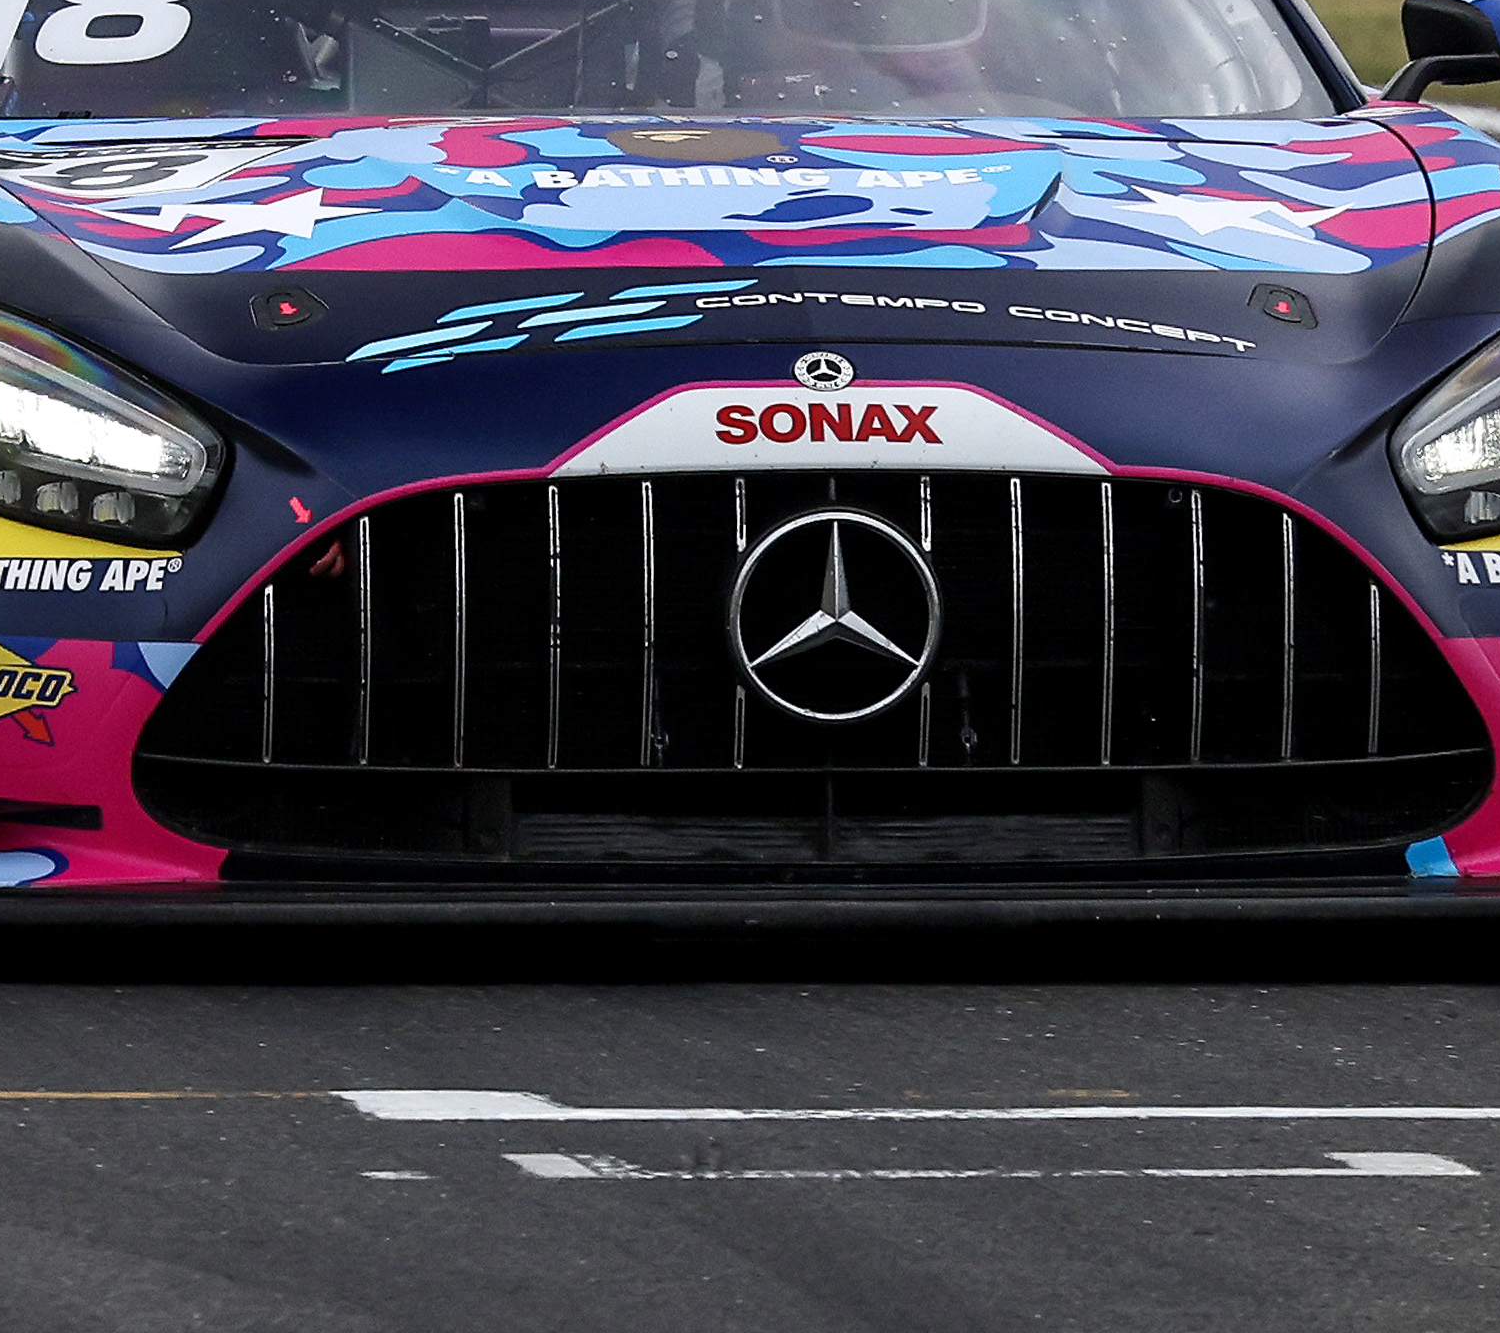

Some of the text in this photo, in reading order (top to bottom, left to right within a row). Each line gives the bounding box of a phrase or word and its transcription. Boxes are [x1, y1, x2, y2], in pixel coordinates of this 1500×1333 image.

[531, 167, 831, 189] BATHING
[695, 292, 1257, 352] CONTEMPO CONCEPT
[715, 403, 944, 445] SONAX
